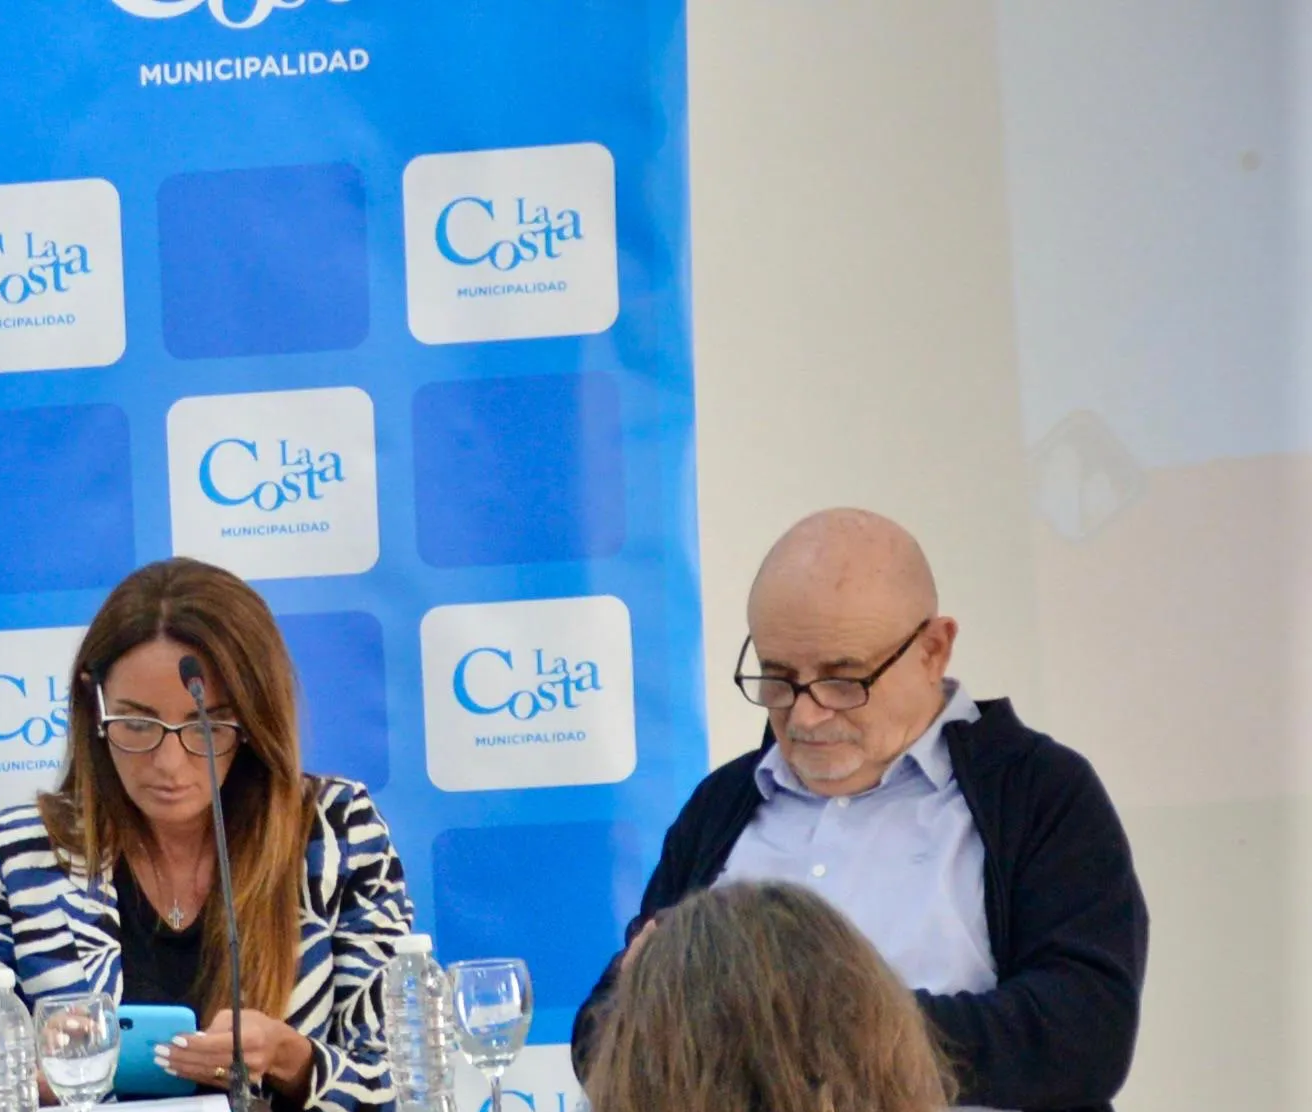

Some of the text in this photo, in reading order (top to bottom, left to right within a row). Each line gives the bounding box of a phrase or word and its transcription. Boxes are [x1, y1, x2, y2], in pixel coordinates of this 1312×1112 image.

[139, 47, 370, 87] MUNICIPALIDAD
[513, 195, 548, 225] La
[23, 230, 57, 259] La
[433, 195, 584, 272] Costa
[457, 280, 568, 299] MUNICIPALIDAD
[277, 437, 311, 466] La
[198, 437, 347, 513] Costa
[221, 521, 331, 538] MUNICIPALIDAD
[531, 646, 566, 674] La
[451, 646, 602, 720] Costa
[475, 731, 587, 747] MUNICIPALIDAD
